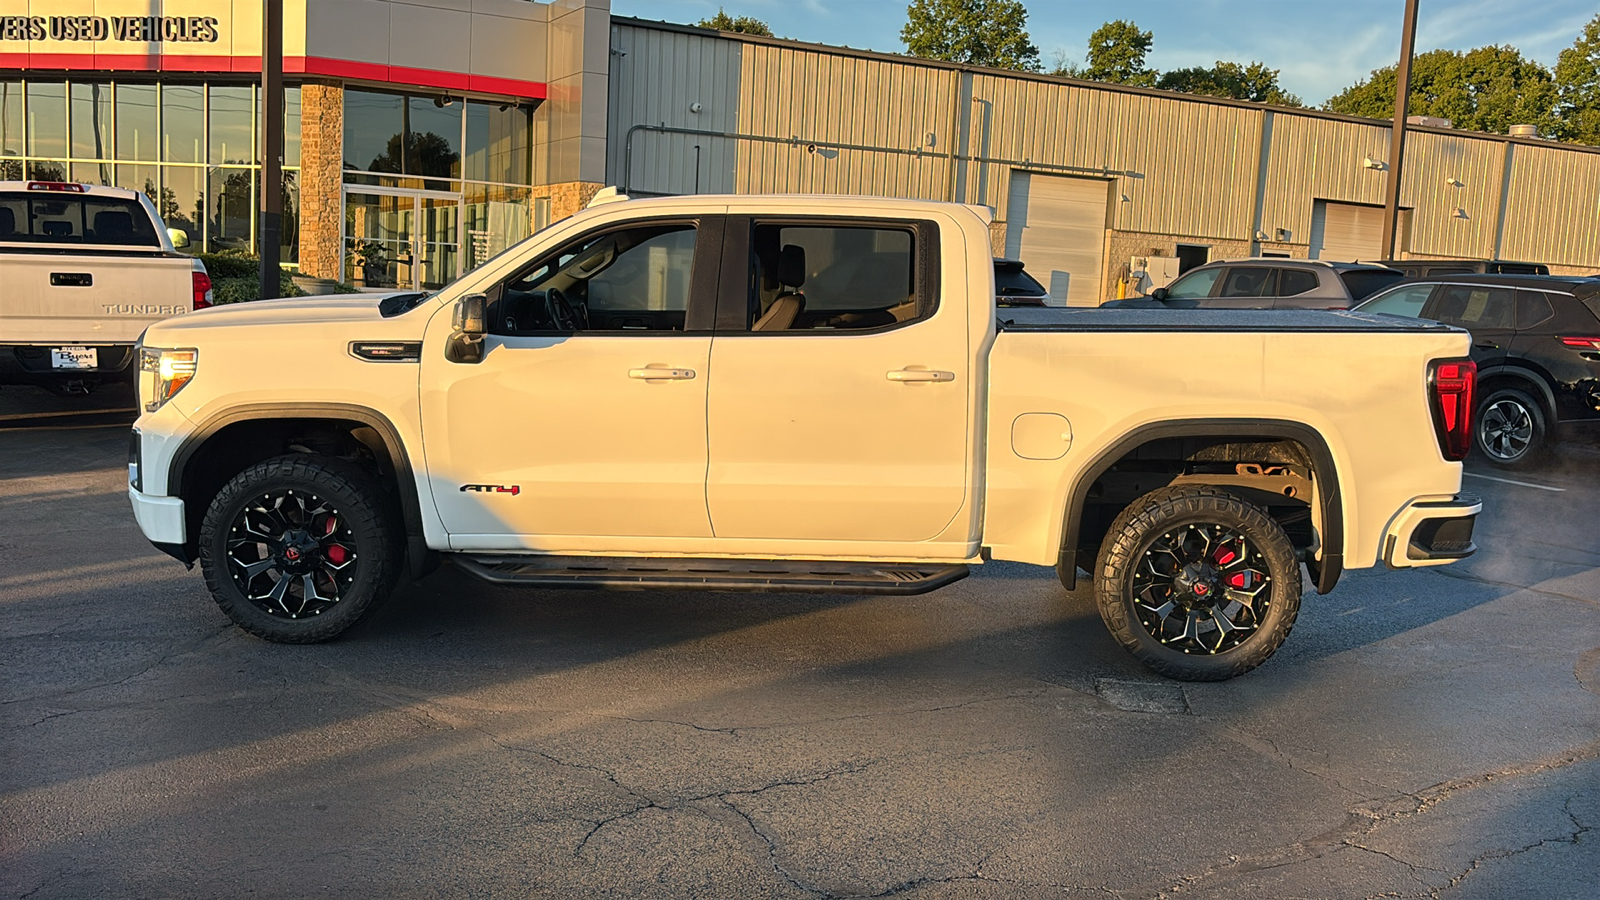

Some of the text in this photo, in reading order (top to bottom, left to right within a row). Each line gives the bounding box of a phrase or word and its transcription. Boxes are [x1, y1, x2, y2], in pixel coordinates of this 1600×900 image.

[49, 16, 108, 40] USED
[111, 16, 218, 42] VEHICLES
[102, 304, 188, 315] TUNDRA
[459, 484, 520, 496] AT4
